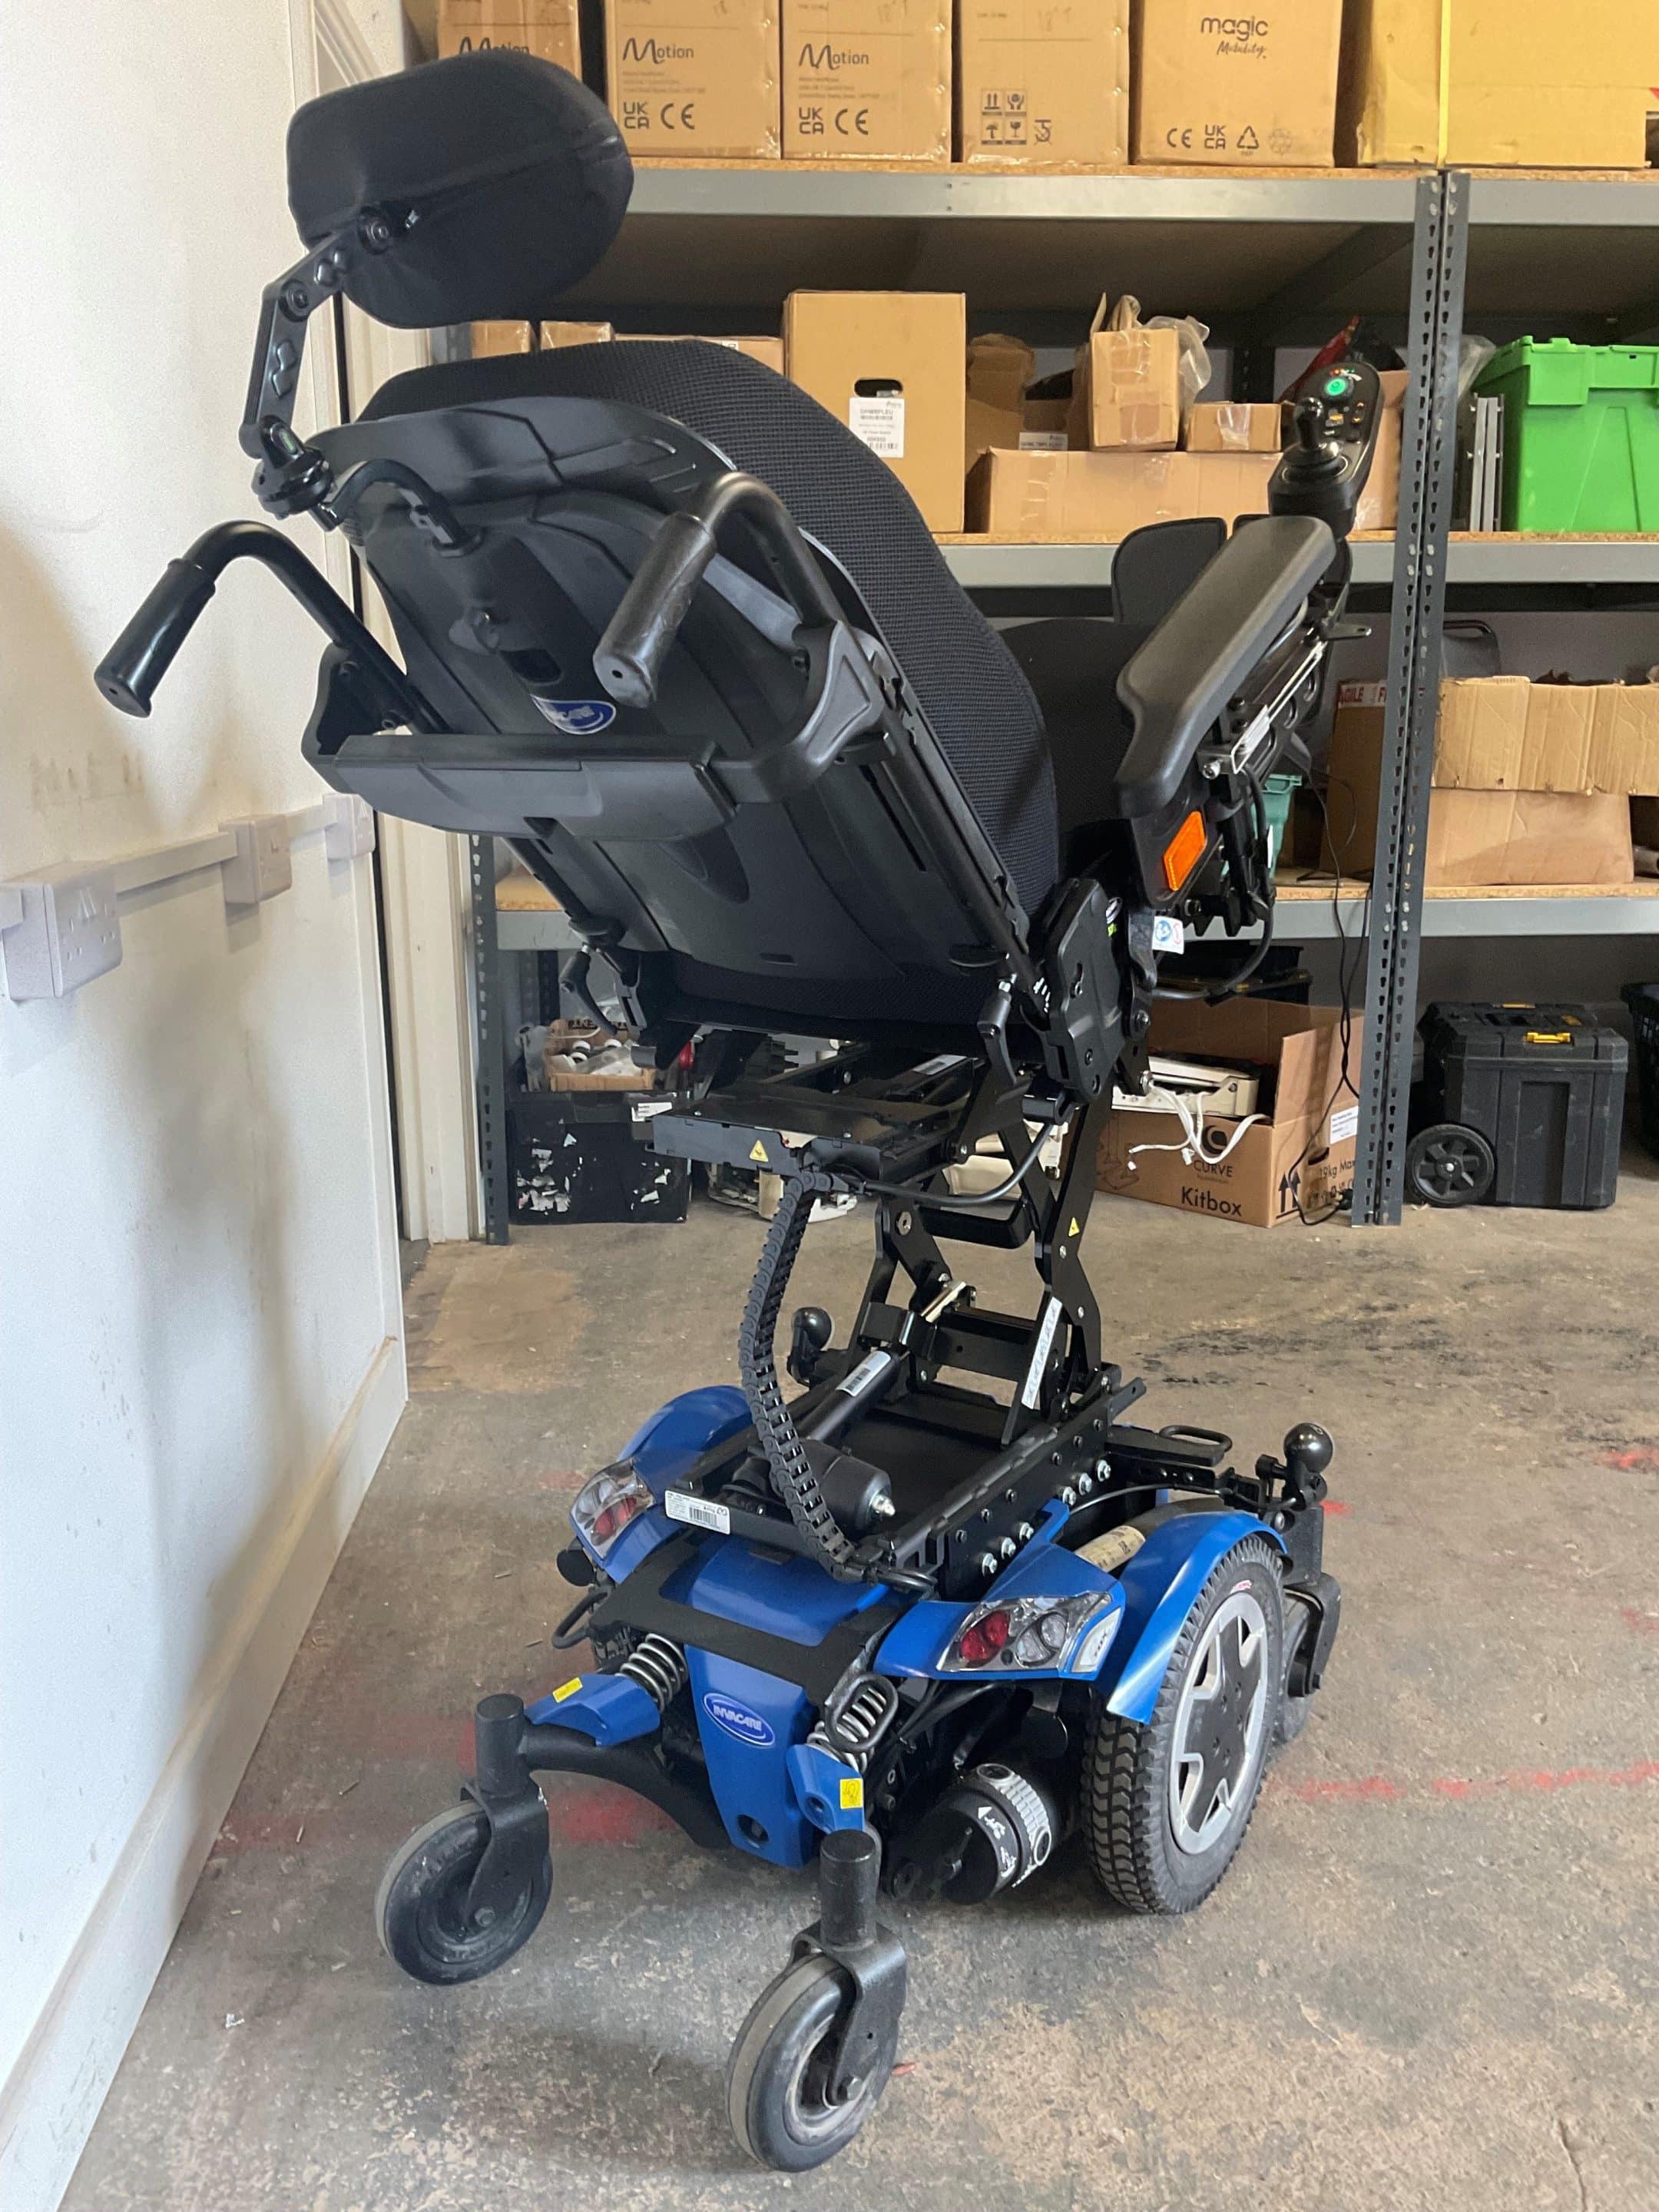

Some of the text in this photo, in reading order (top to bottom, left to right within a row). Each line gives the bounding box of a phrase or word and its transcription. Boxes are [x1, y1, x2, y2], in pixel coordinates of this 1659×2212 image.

[1200, 15, 1269, 41] magic
[622, 37, 694, 65] Motion
[798, 43, 869, 70] Motion
[623, 101, 649, 114] UK
[798, 107, 823, 121] UK
[624, 116, 650, 129] CA
[799, 121, 824, 135] CA
[1204, 124, 1227, 137] UK
[1204, 137, 1227, 151] CA
[1193, 1159, 1233, 1178] CURVE
[1181, 1185, 1243, 1217] Kitbox
[714, 1704, 763, 1733] INVACARE
